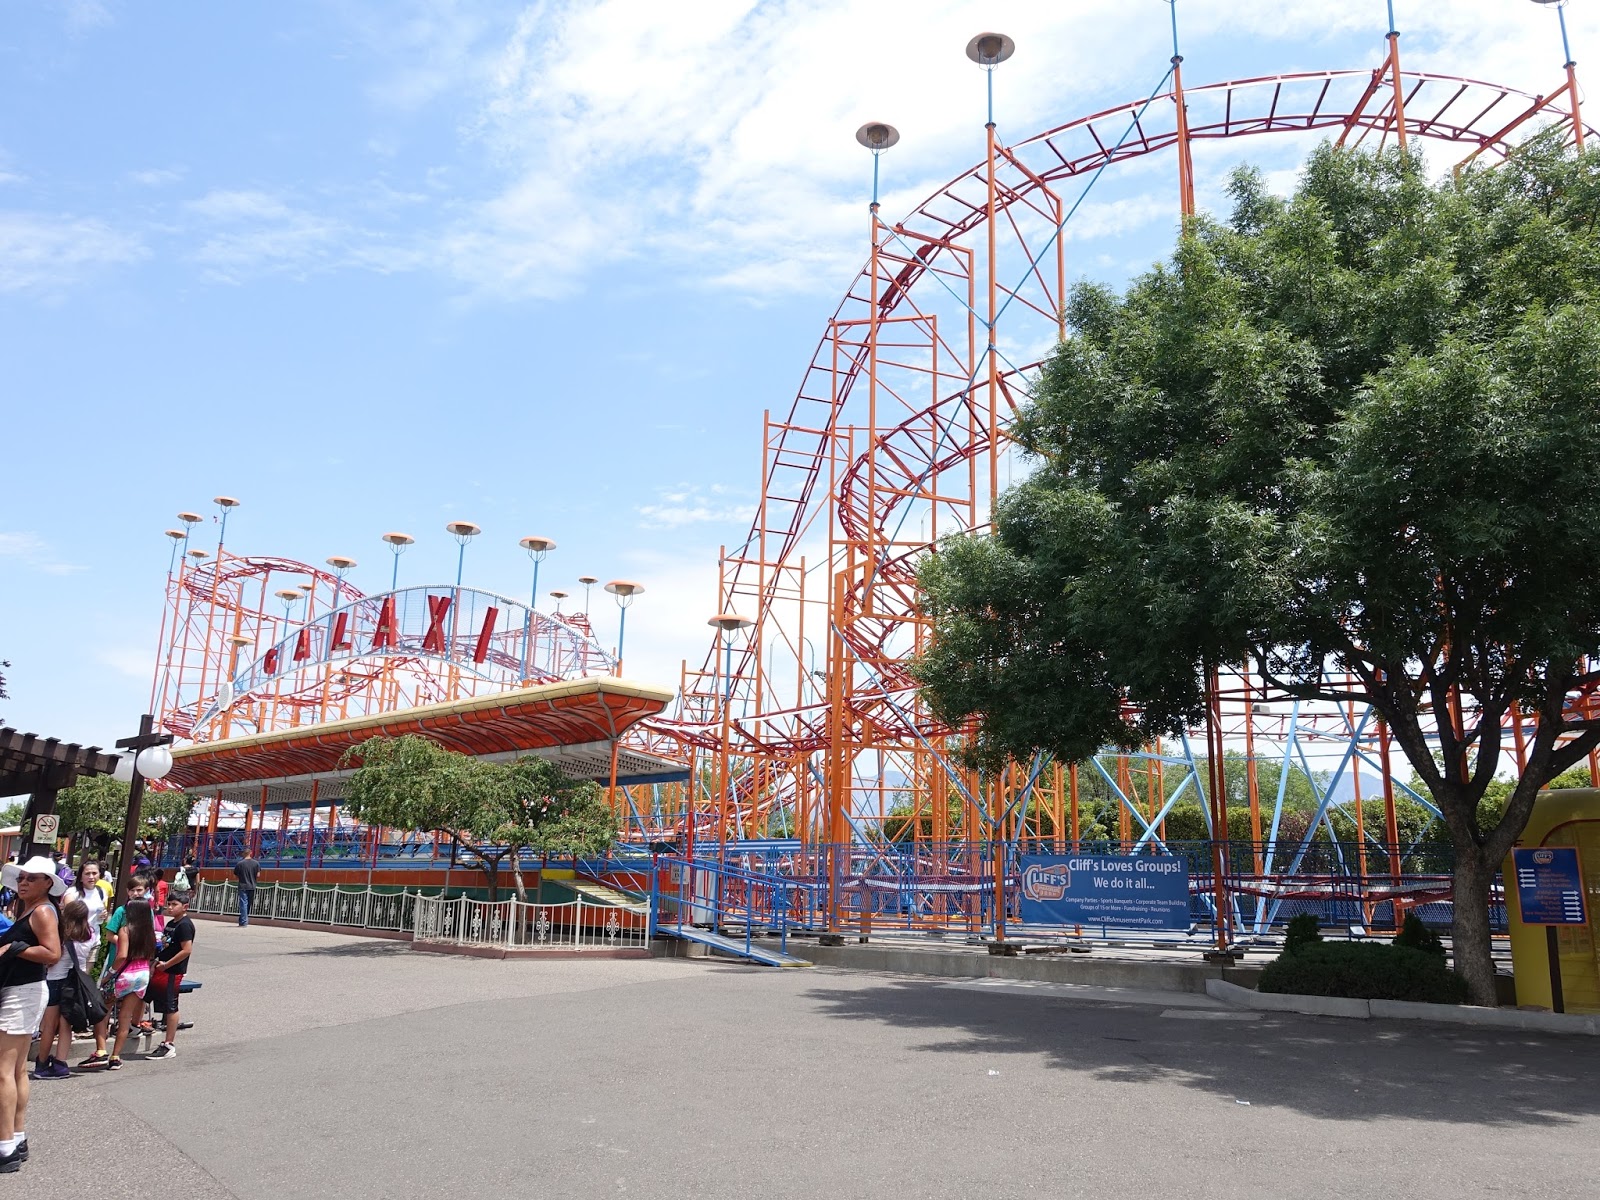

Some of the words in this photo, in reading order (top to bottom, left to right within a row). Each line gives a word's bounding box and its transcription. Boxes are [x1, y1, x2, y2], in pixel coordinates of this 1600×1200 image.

[263, 595, 499, 674] GALAXI
[1069, 859, 1099, 871] Cliff's
[1101, 860, 1133, 872] Loves
[1135, 860, 1181, 875] Groups!
[1026, 867, 1067, 899] CLIFF'S
[1093, 877, 1109, 888] We
[1111, 877, 1124, 888] do
[1126, 878, 1133, 888] it
[1135, 878, 1155, 890] all...
[1065, 896, 1084, 904] Company
[1135, 898, 1156, 906] Corporate
[1169, 899, 1186, 907] Building
[1123, 905, 1148, 913] Fundraising
[1087, 916, 1164, 924] www.CliffsAmusementPark.com
